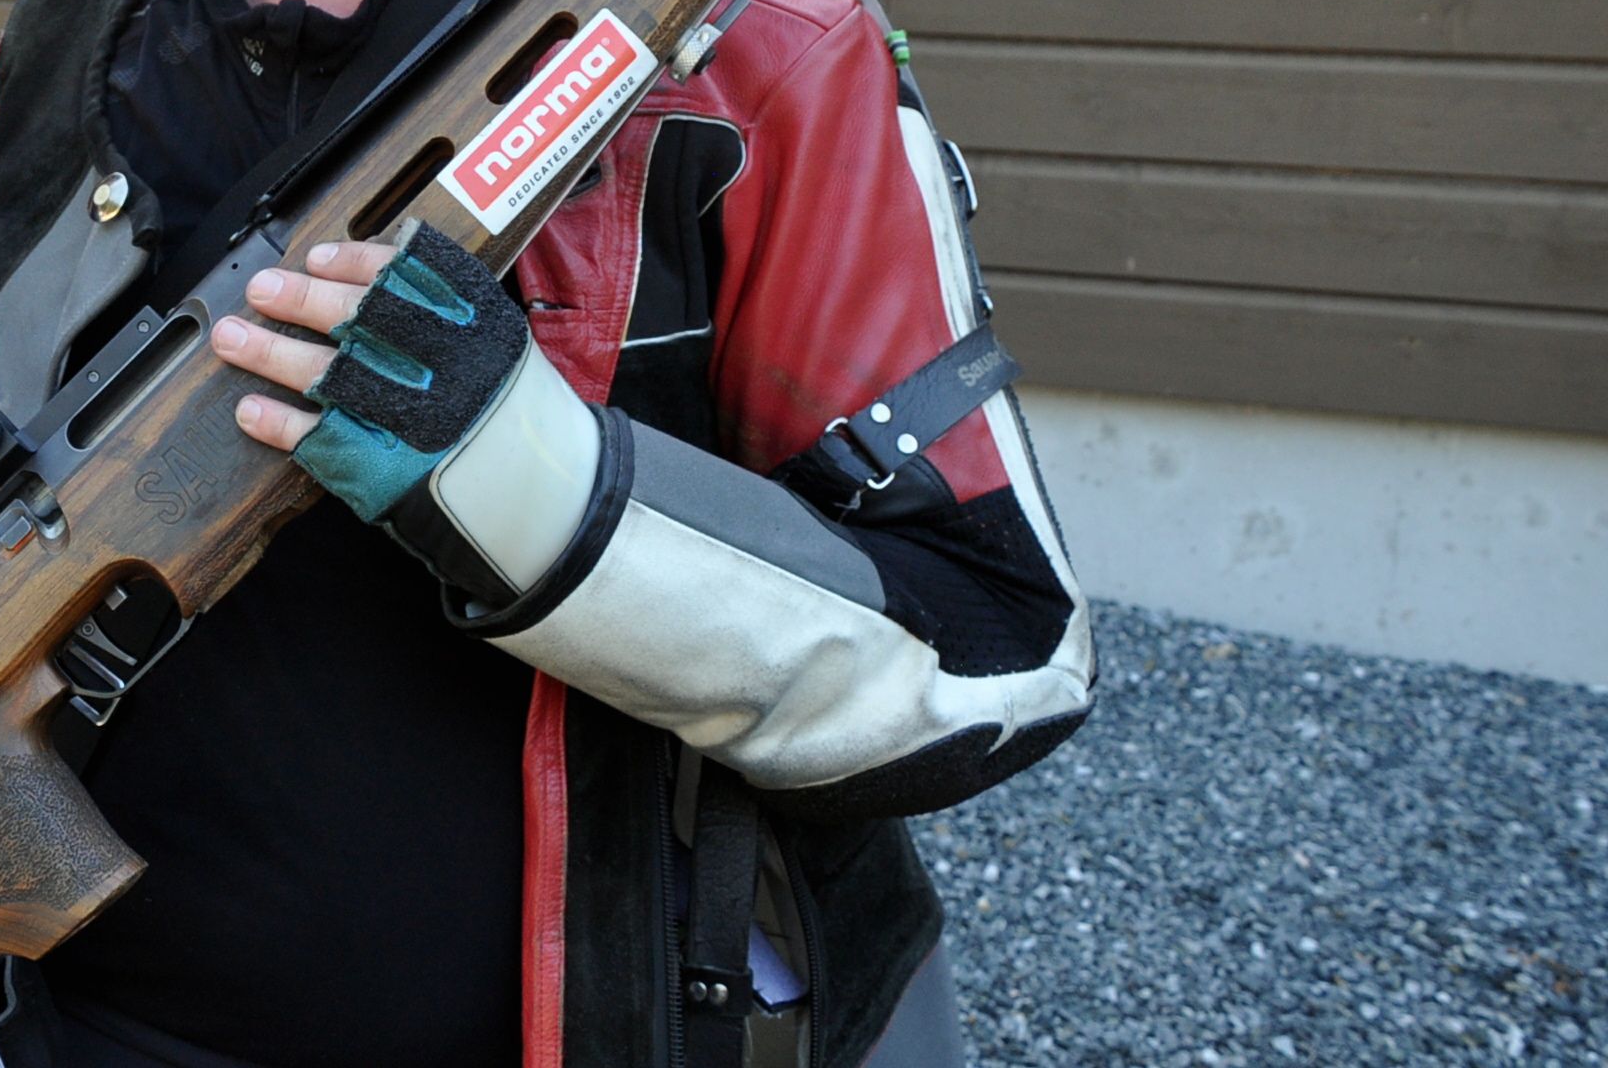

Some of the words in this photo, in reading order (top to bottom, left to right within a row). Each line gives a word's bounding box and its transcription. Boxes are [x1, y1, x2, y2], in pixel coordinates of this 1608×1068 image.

[474, 43, 616, 187] norma
[508, 145, 568, 208] DEDICATED
[571, 108, 604, 144] SINCE
[607, 76, 636, 106] 1902
